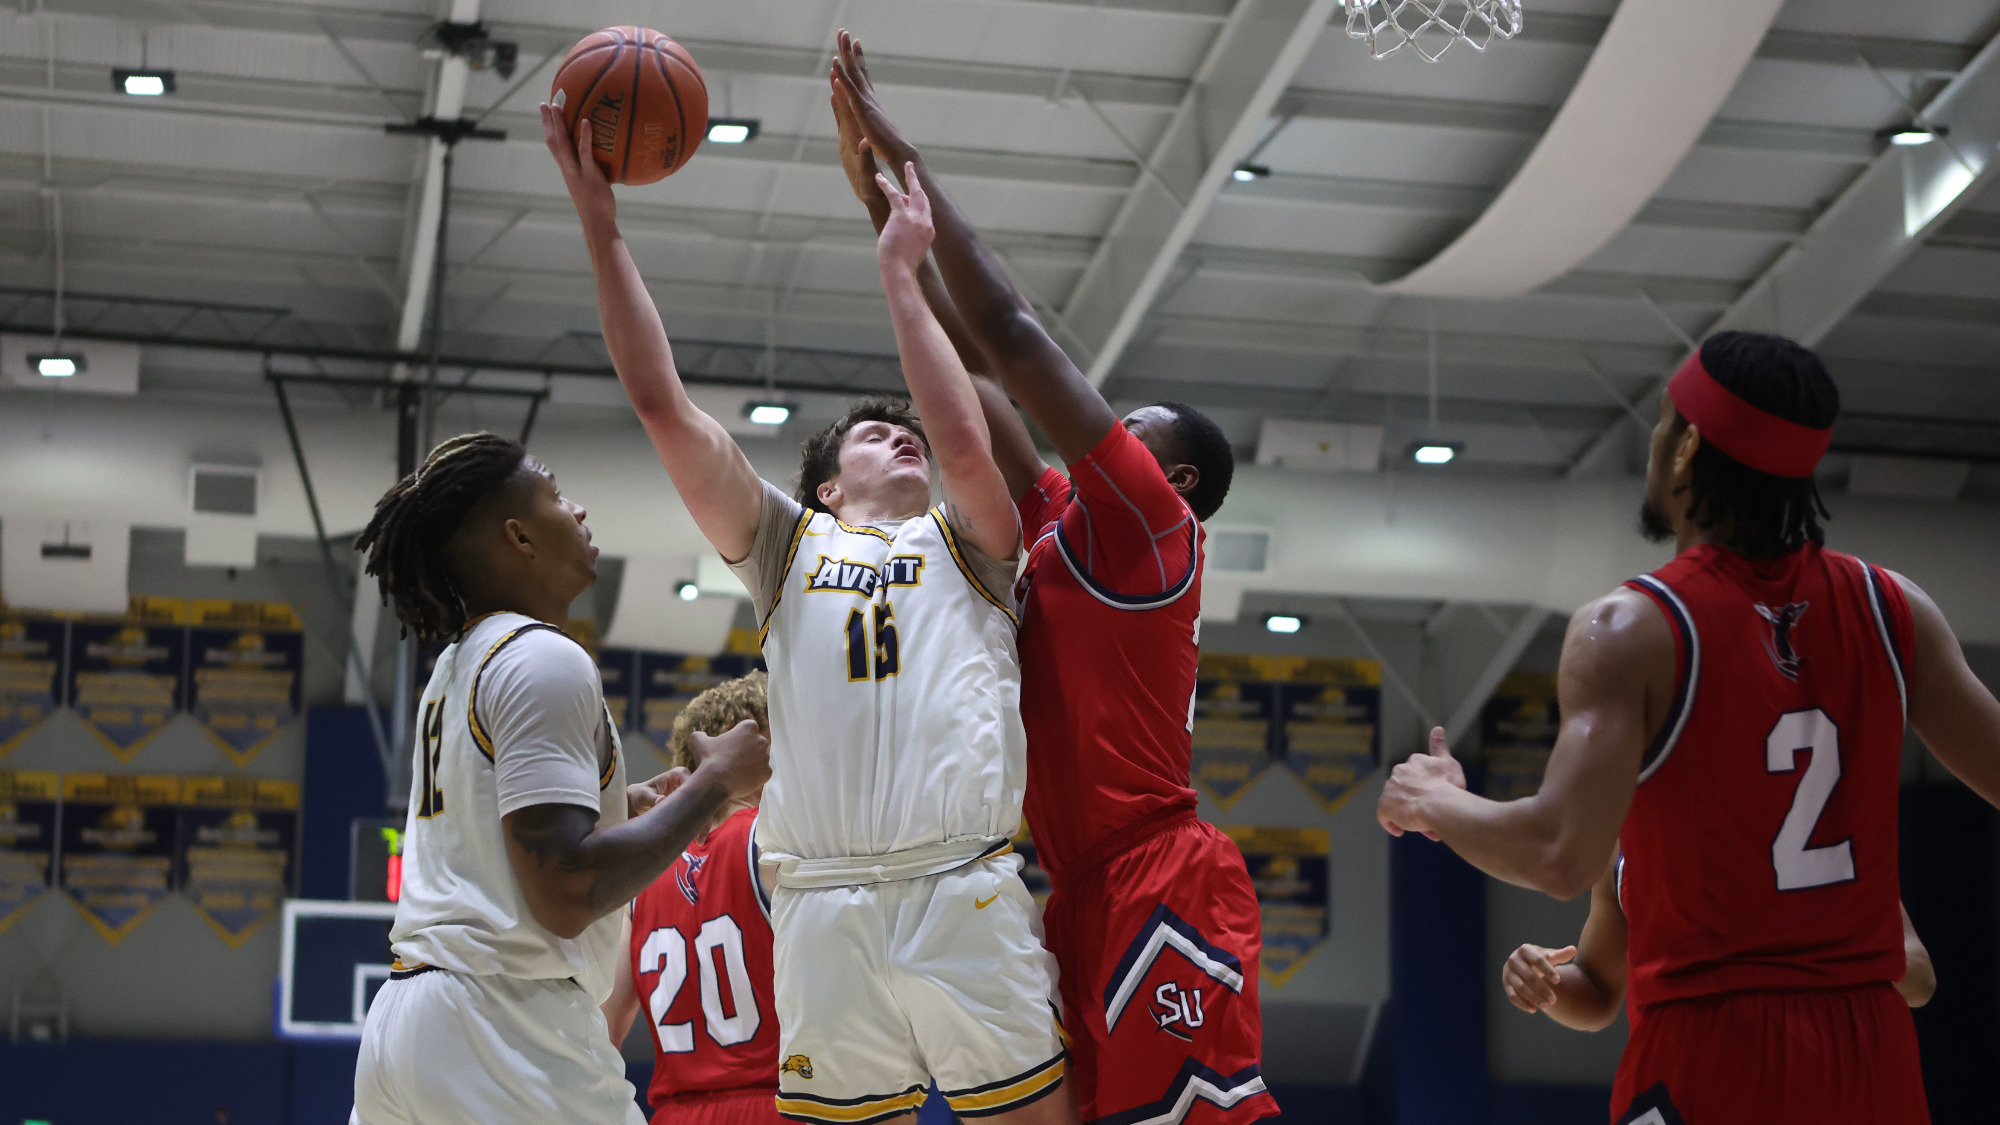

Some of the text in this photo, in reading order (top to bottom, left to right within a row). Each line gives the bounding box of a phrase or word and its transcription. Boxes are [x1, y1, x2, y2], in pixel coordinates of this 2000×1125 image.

[805, 554, 924, 599] AVETT
[845, 601, 900, 682] 15
[1766, 705, 1857, 893] 2
[640, 913, 761, 1054] 20
[1154, 980, 1205, 1029] SU
